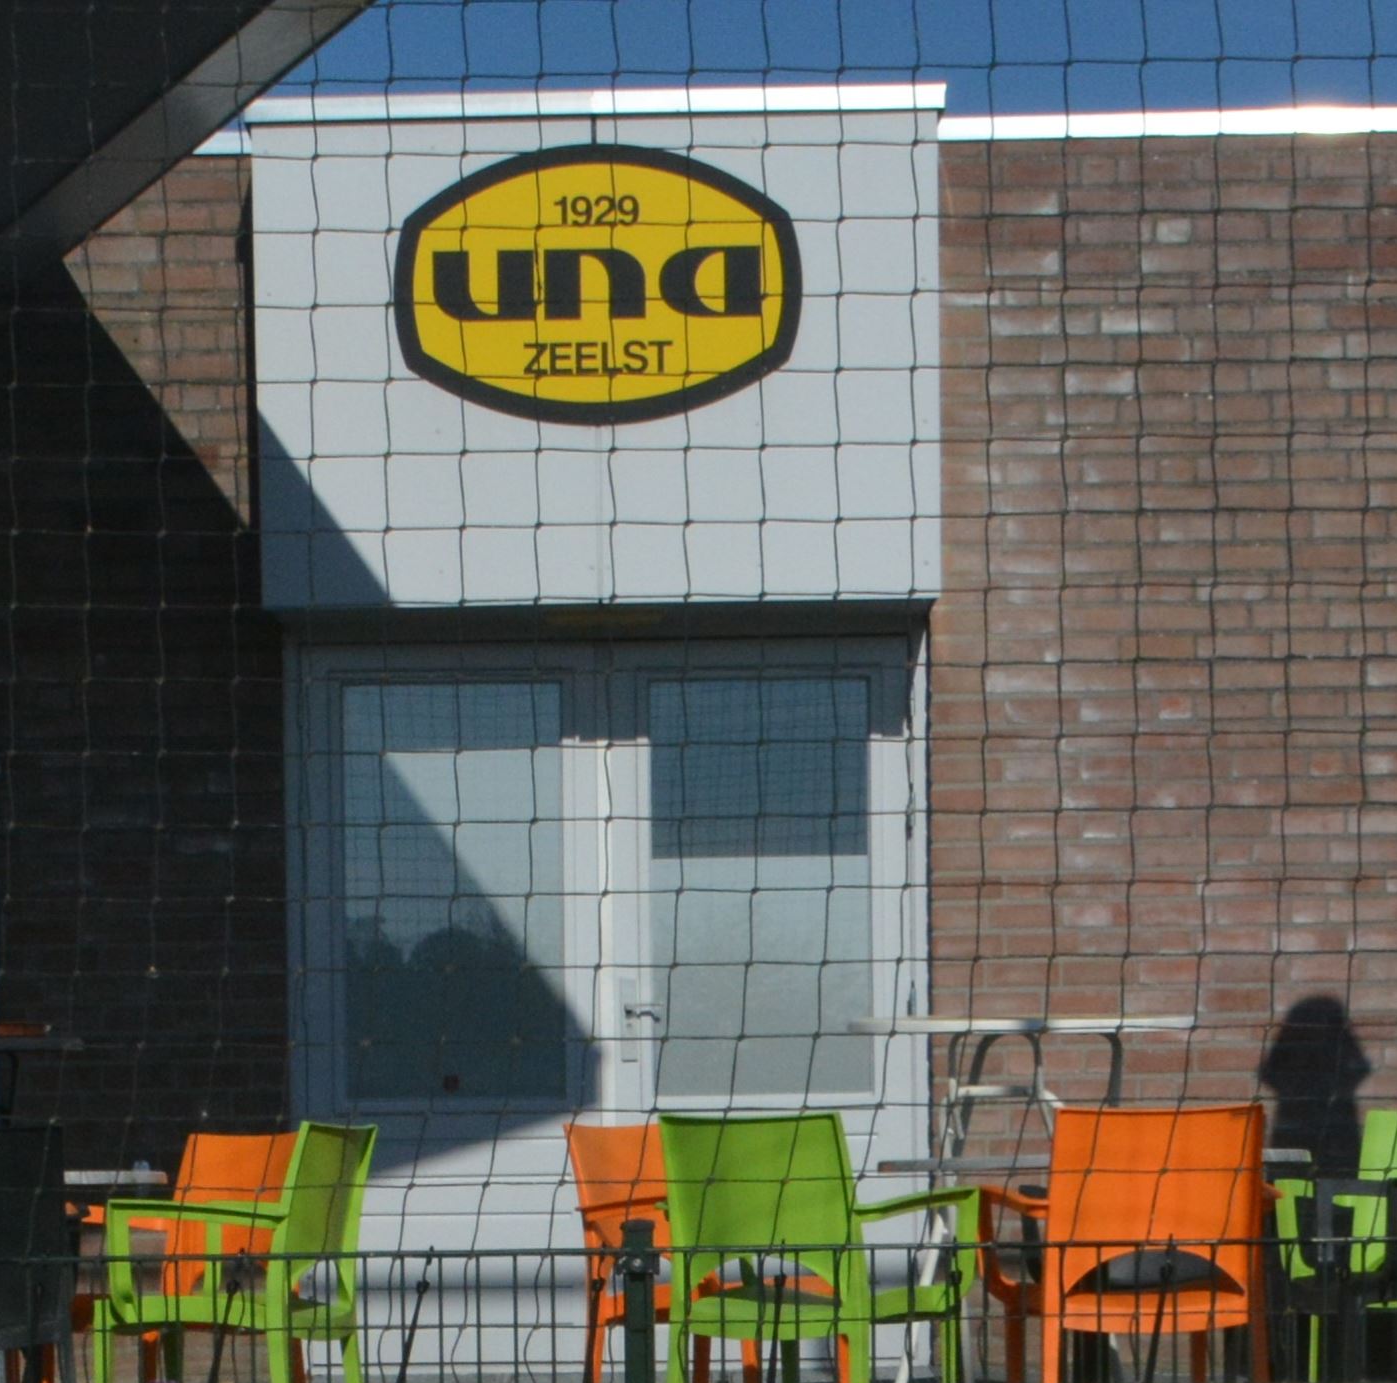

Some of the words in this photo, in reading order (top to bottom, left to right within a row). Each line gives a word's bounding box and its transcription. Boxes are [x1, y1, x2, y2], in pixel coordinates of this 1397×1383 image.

[554, 195, 640, 227] 1929
[432, 245, 762, 322] una
[523, 340, 673, 377] ZEELST
